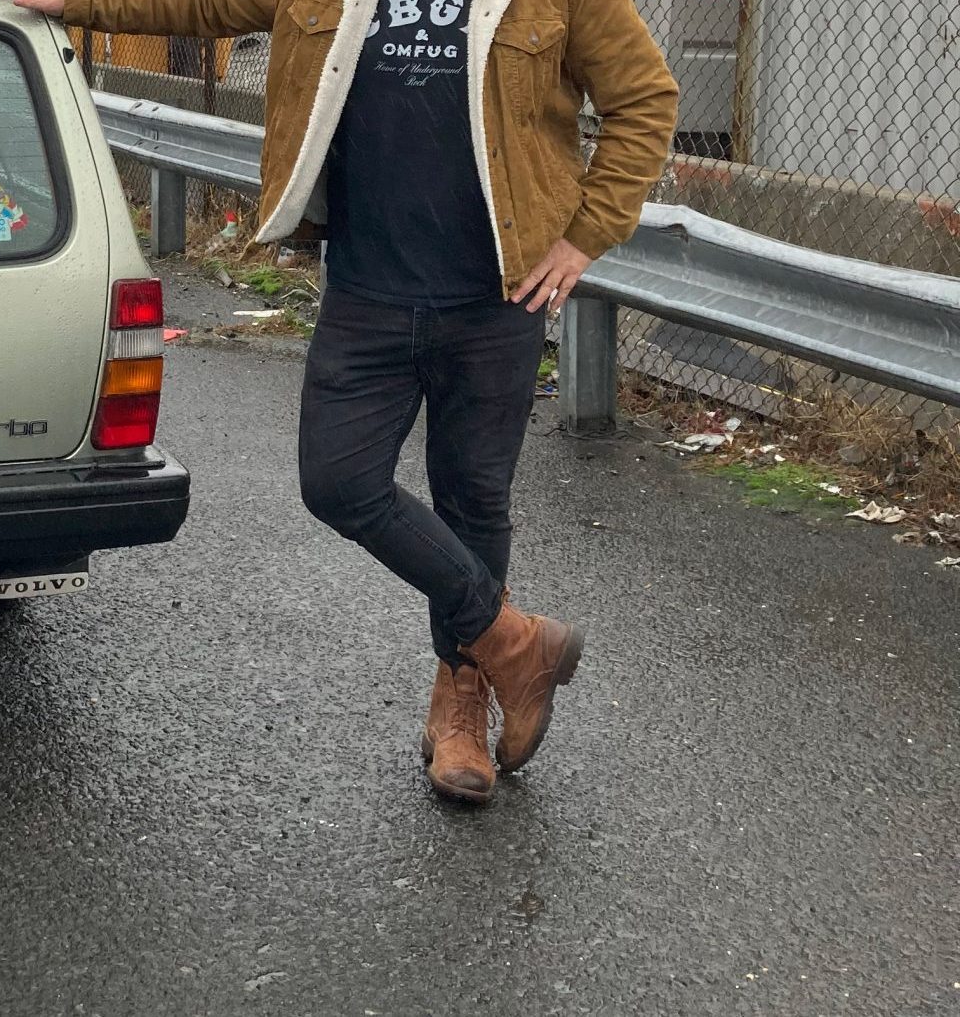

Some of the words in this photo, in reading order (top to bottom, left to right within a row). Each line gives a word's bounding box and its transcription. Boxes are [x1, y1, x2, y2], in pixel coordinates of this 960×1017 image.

[415, 28, 429, 41] &
[382, 43, 459, 59] OMFUG
[373, 61, 396, 73] Home
[398, 63, 410, 77] of
[410, 63, 464, 78] Underground
[404, 75, 430, 87] Rock
